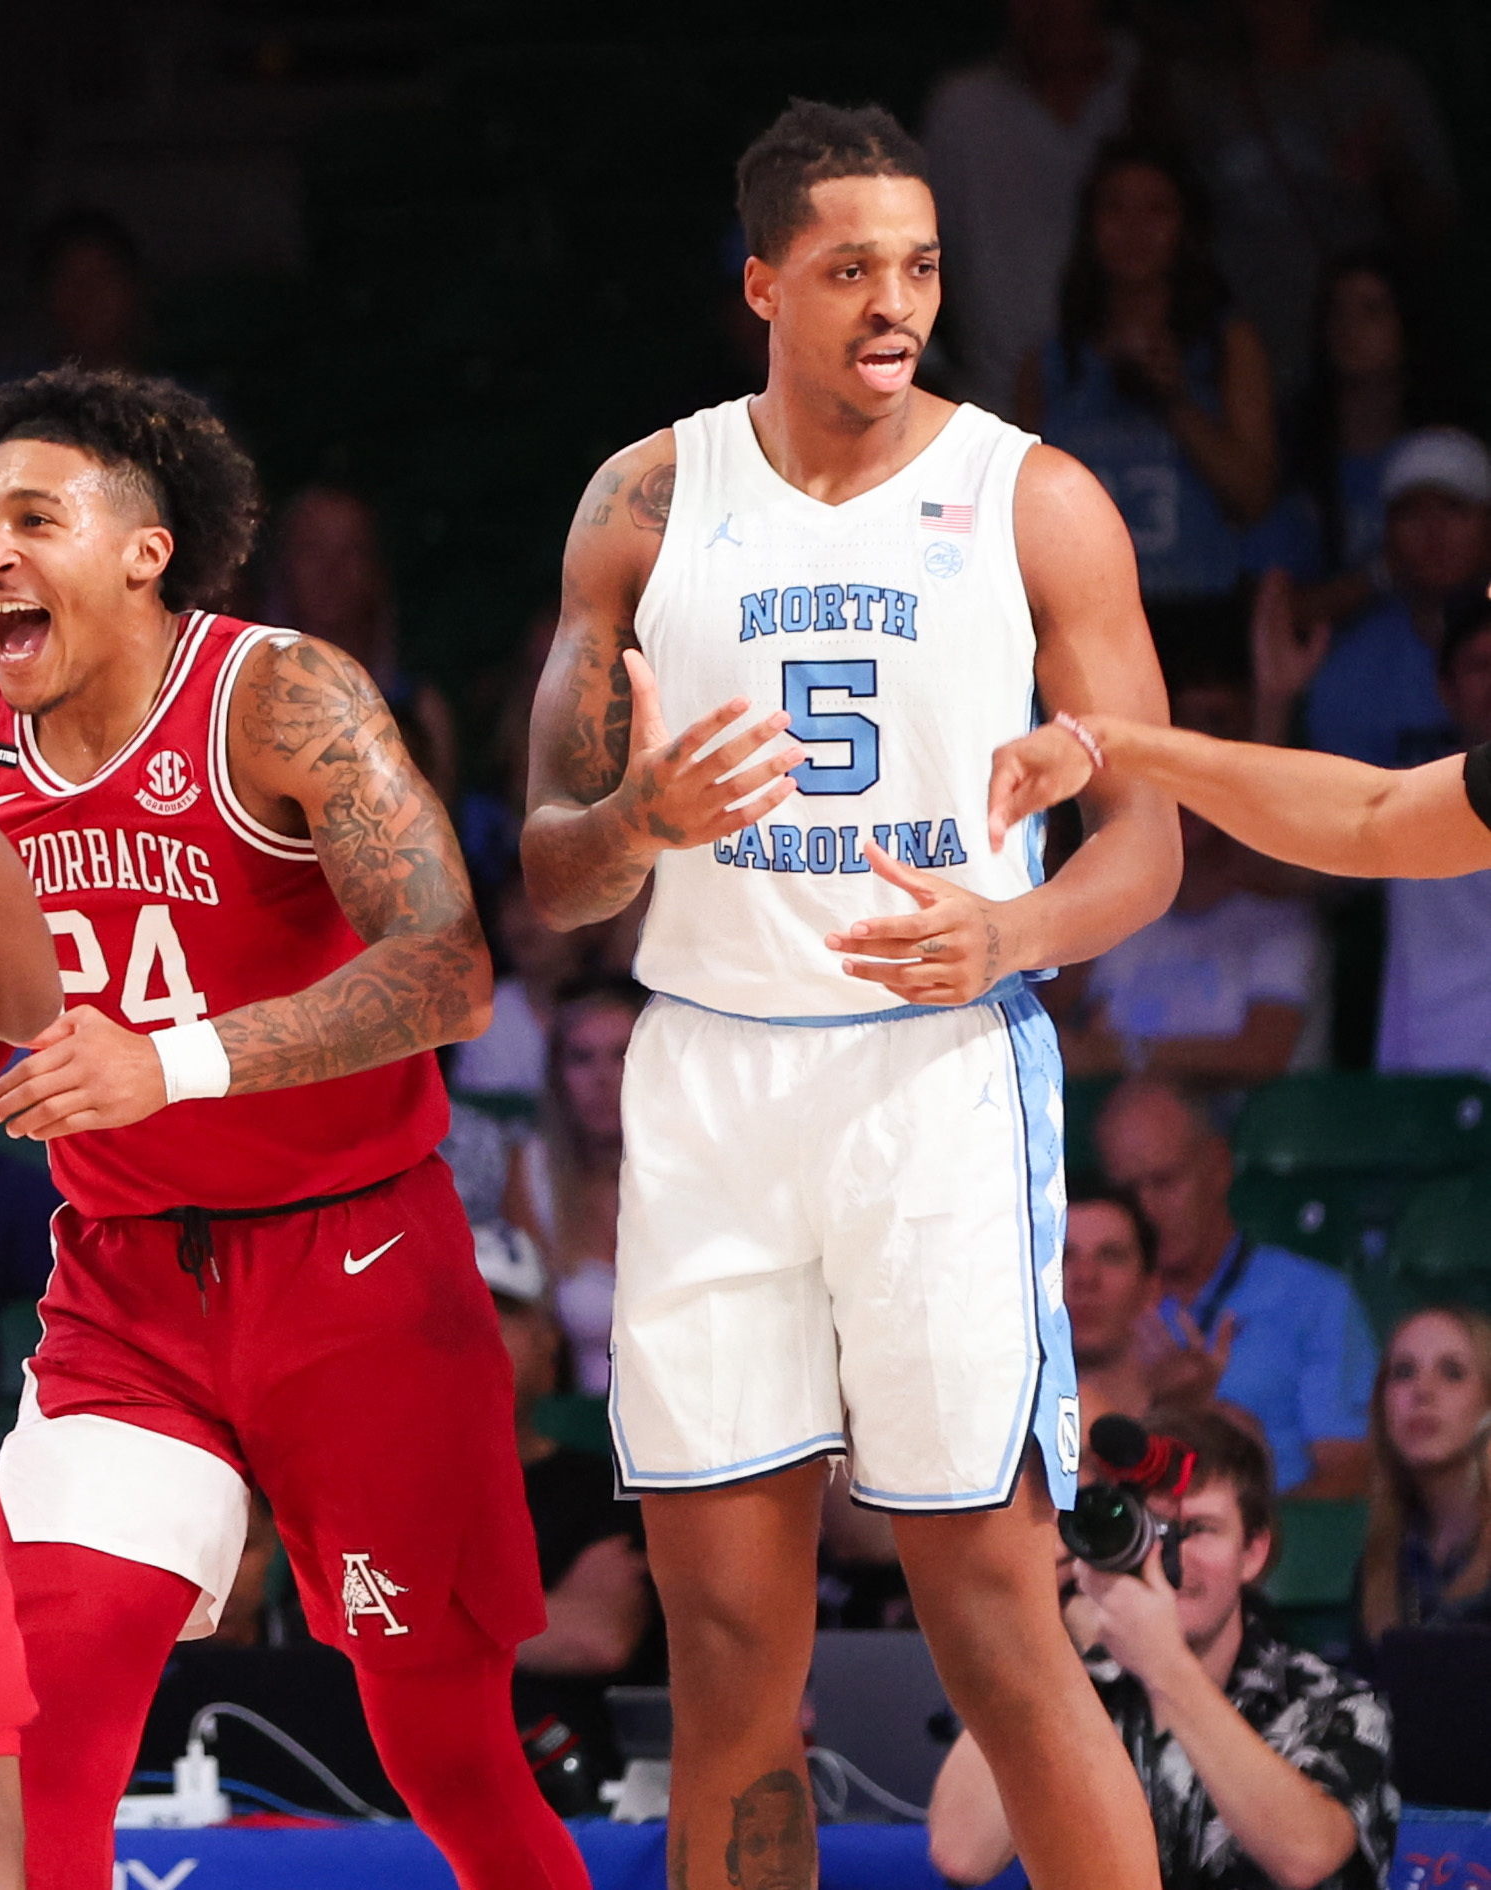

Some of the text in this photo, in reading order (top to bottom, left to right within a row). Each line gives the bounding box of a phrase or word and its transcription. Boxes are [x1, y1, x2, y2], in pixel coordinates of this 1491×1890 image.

[740, 584, 918, 643] NORTH
[782, 659, 880, 796] 5
[146, 749, 187, 796] SEC
[145, 795, 192, 812] GRADUATE
[18, 828, 220, 906] ZORBACKS
